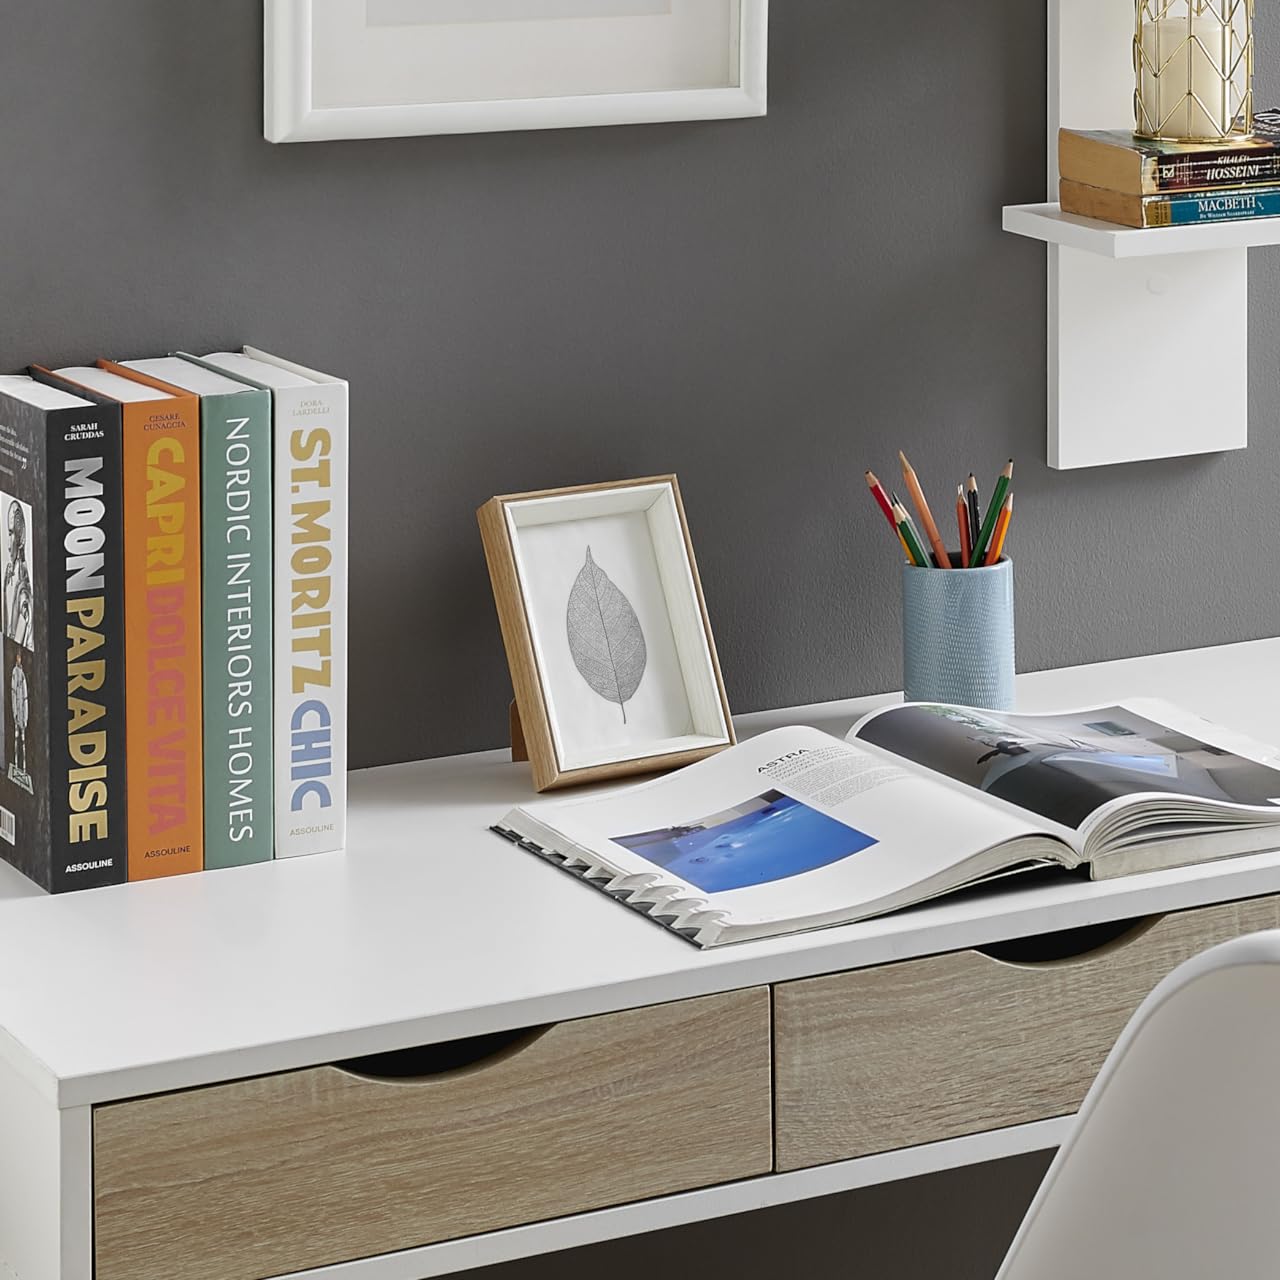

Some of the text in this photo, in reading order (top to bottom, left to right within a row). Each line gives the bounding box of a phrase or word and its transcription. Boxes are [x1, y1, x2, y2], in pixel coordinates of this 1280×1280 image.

[1206, 164, 1260, 181] HOSSEINI
[1198, 195, 1256, 213] MACBETH
[149, 413, 180, 422] CESARE
[64, 430, 104, 441] CRUDDAS
[70, 422, 98, 432] SARAH
[289, 428, 332, 812] ST. MORITZ CHIC
[145, 437, 188, 837] CAPRI DOLCE VITA
[226, 417, 253, 842] NORDIC INTERIORS HOMES
[63, 456, 109, 844] MOON PARADISE
[757, 747, 809, 773] ASTRA
[289, 823, 335, 837] ASSOULINE
[144, 845, 192, 860] ASSOULINE
[65, 858, 113, 874] ASSOULINE
